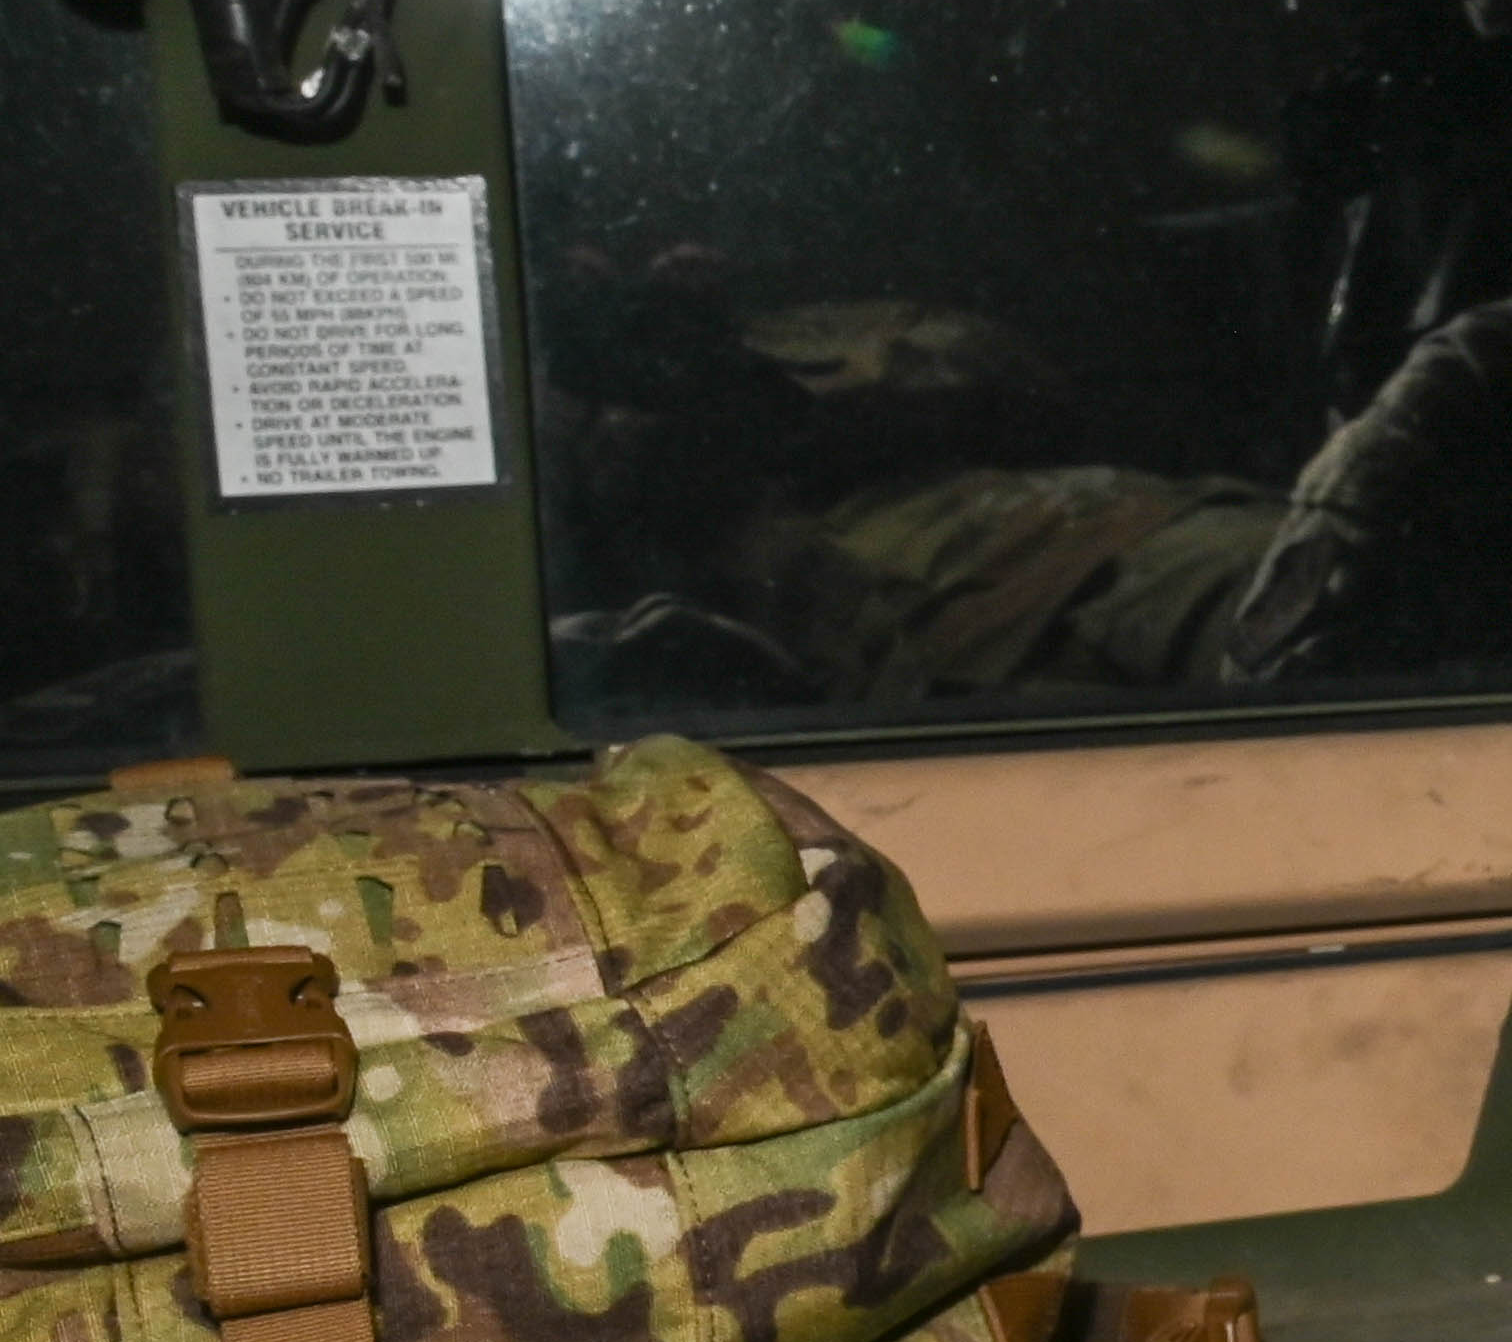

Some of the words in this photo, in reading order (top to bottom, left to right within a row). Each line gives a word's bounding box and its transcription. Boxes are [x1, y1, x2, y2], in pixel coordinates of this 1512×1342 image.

[221, 199, 320, 218] VEHICLE
[333, 198, 443, 217] BREAK-IN
[285, 221, 385, 241] SERVICE
[312, 254, 343, 267] THE
[317, 271, 338, 285] OF
[238, 291, 265, 305] DO
[271, 290, 305, 304] NOT
[313, 289, 383, 304] EXCEED
[390, 289, 400, 300] A
[407, 286, 463, 301] SPEED
[241, 310, 261, 324] OF
[297, 309, 334, 321] MPH
[243, 327, 268, 341] DO
[275, 326, 308, 339] NOT
[316, 325, 366, 339] DRIVE
[376, 323, 409, 337] FOR
[416, 322, 464, 336] LONG
[245, 344, 321, 359] PERIODS
[328, 343, 349, 357] OF
[360, 342, 395, 355] TIME
[405, 341, 423, 353] AT
[247, 361, 340, 376] CONSTANT
[250, 379, 300, 394] AVOID
[308, 378, 361, 392] RAPID
[251, 397, 290, 412] TION
[300, 396, 323, 409] OR
[252, 415, 301, 430] DRIVE
[311, 414, 330, 428] AT
[338, 411, 430, 426] MODERATE
[255, 434, 311, 449] SPEED
[318, 432, 365, 447] UNTIL
[376, 430, 404, 444] THE
[413, 427, 474, 442] ENGINE
[256, 453, 271, 467] IS
[277, 451, 331, 466] FULLY
[338, 448, 413, 463] WARMED
[256, 471, 282, 484] NO
[291, 468, 363, 483] TRAILER
